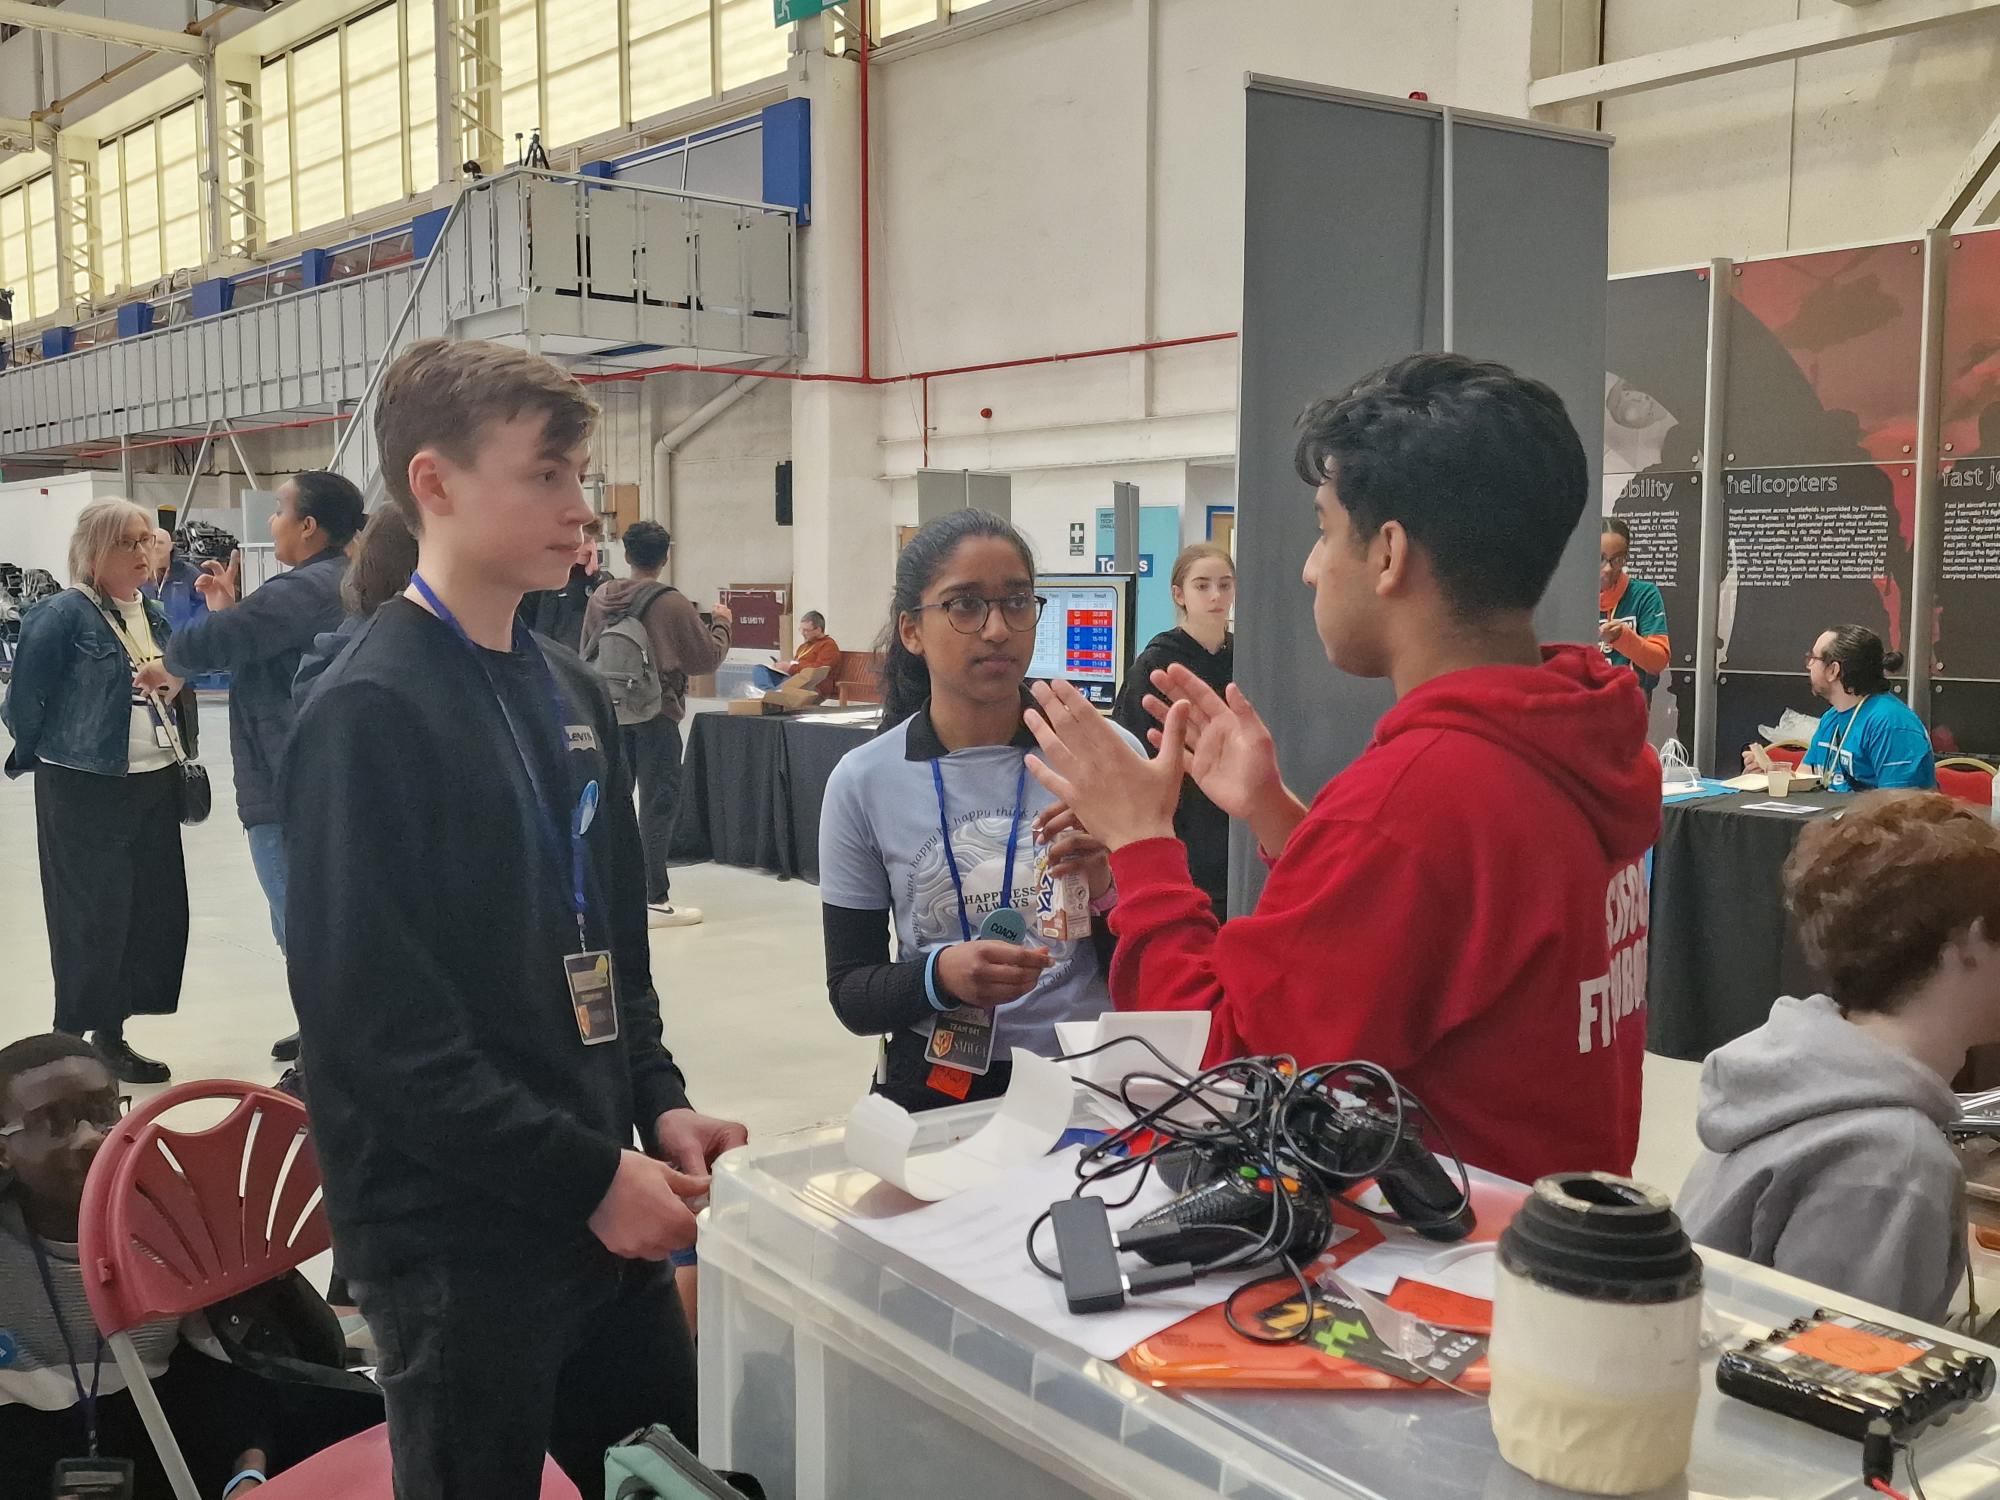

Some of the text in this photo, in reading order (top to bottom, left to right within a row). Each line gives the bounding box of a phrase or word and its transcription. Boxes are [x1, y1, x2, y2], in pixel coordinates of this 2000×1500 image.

[1727, 475, 1838, 496] helicopters
[1098, 557, 1148, 573] Tos
[910, 834, 938, 868] happy
[954, 808, 991, 826] happy
[996, 806, 1029, 818] thik
[964, 887, 1037, 906] HAPPIESS
[976, 898, 1029, 914] ALWYS
[990, 923, 1018, 942] COACH
